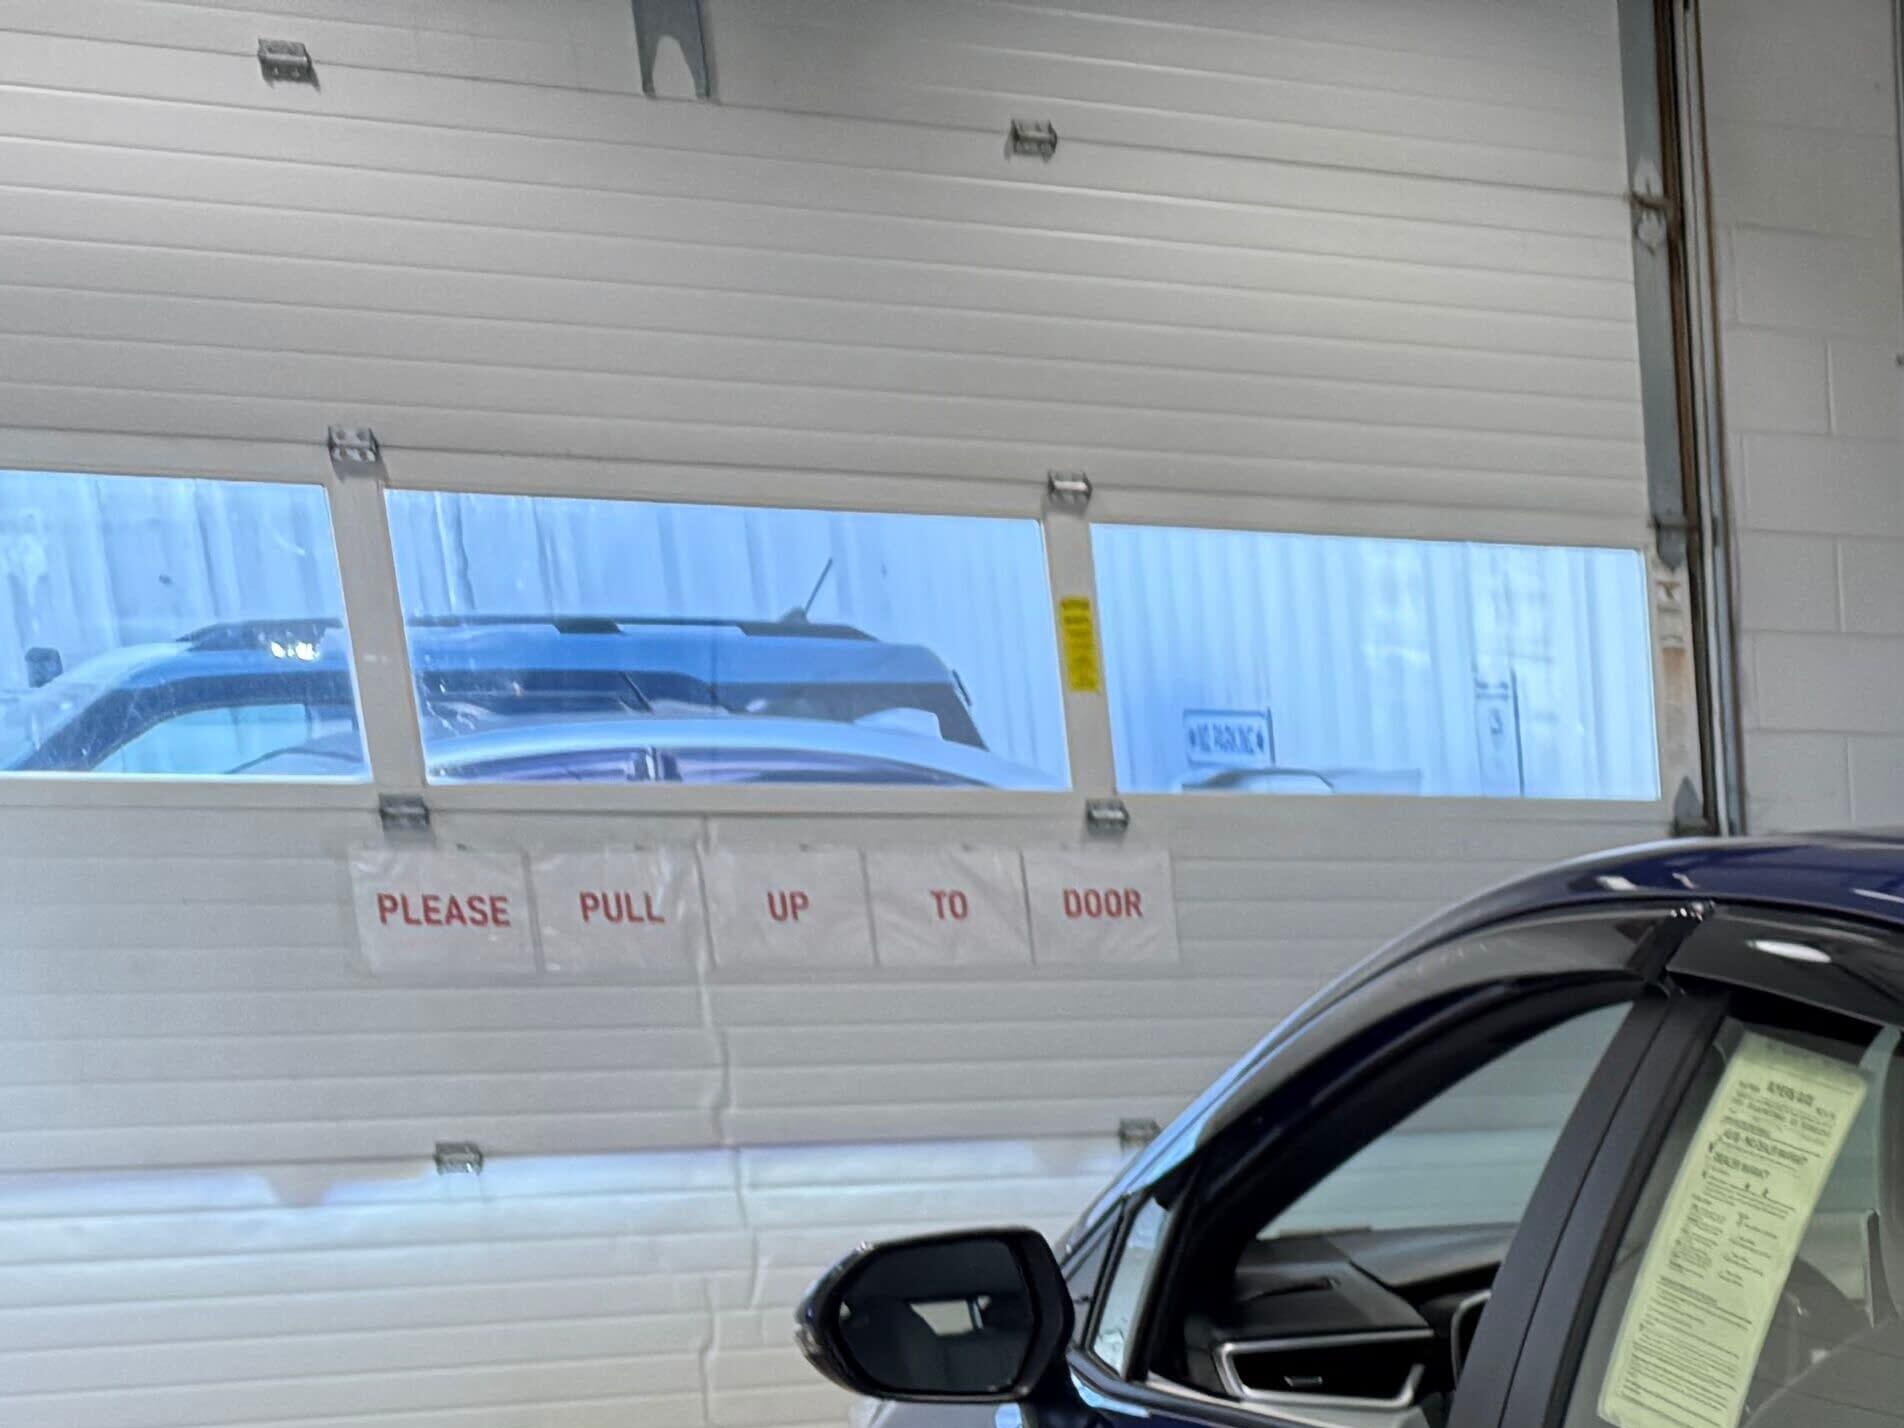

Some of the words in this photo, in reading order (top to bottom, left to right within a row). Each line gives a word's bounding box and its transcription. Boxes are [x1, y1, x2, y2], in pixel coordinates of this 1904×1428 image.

[377, 893, 511, 927] PLEASE
[579, 891, 666, 923] PULL
[767, 890, 810, 922] UP
[930, 889, 968, 921] TO
[1063, 888, 1143, 919] DOOR
